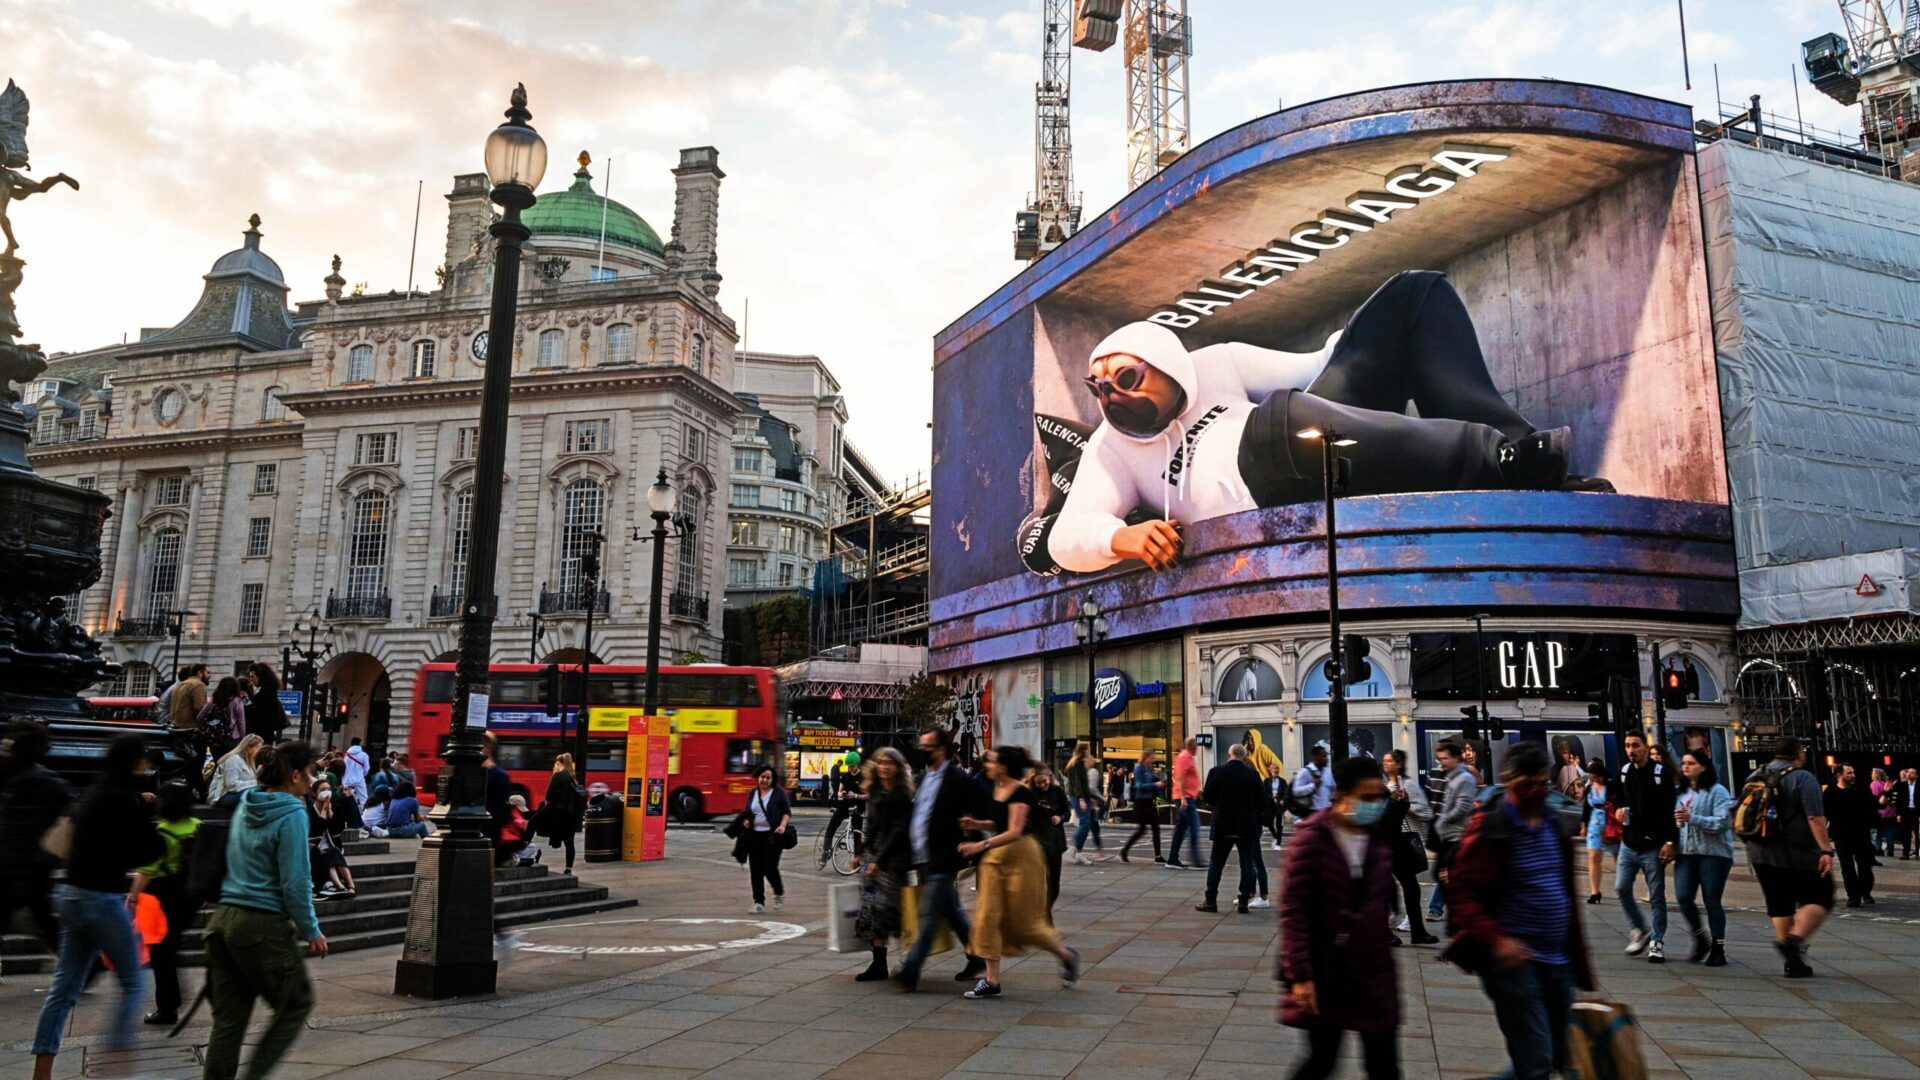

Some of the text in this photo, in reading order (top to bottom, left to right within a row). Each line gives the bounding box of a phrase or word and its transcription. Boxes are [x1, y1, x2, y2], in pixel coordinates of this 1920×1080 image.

[1147, 147, 1510, 329] BALENCIAGA
[1498, 640, 1564, 689] GAP
[1094, 675, 1121, 710] Boots
[1135, 680, 1164, 696] beauty
